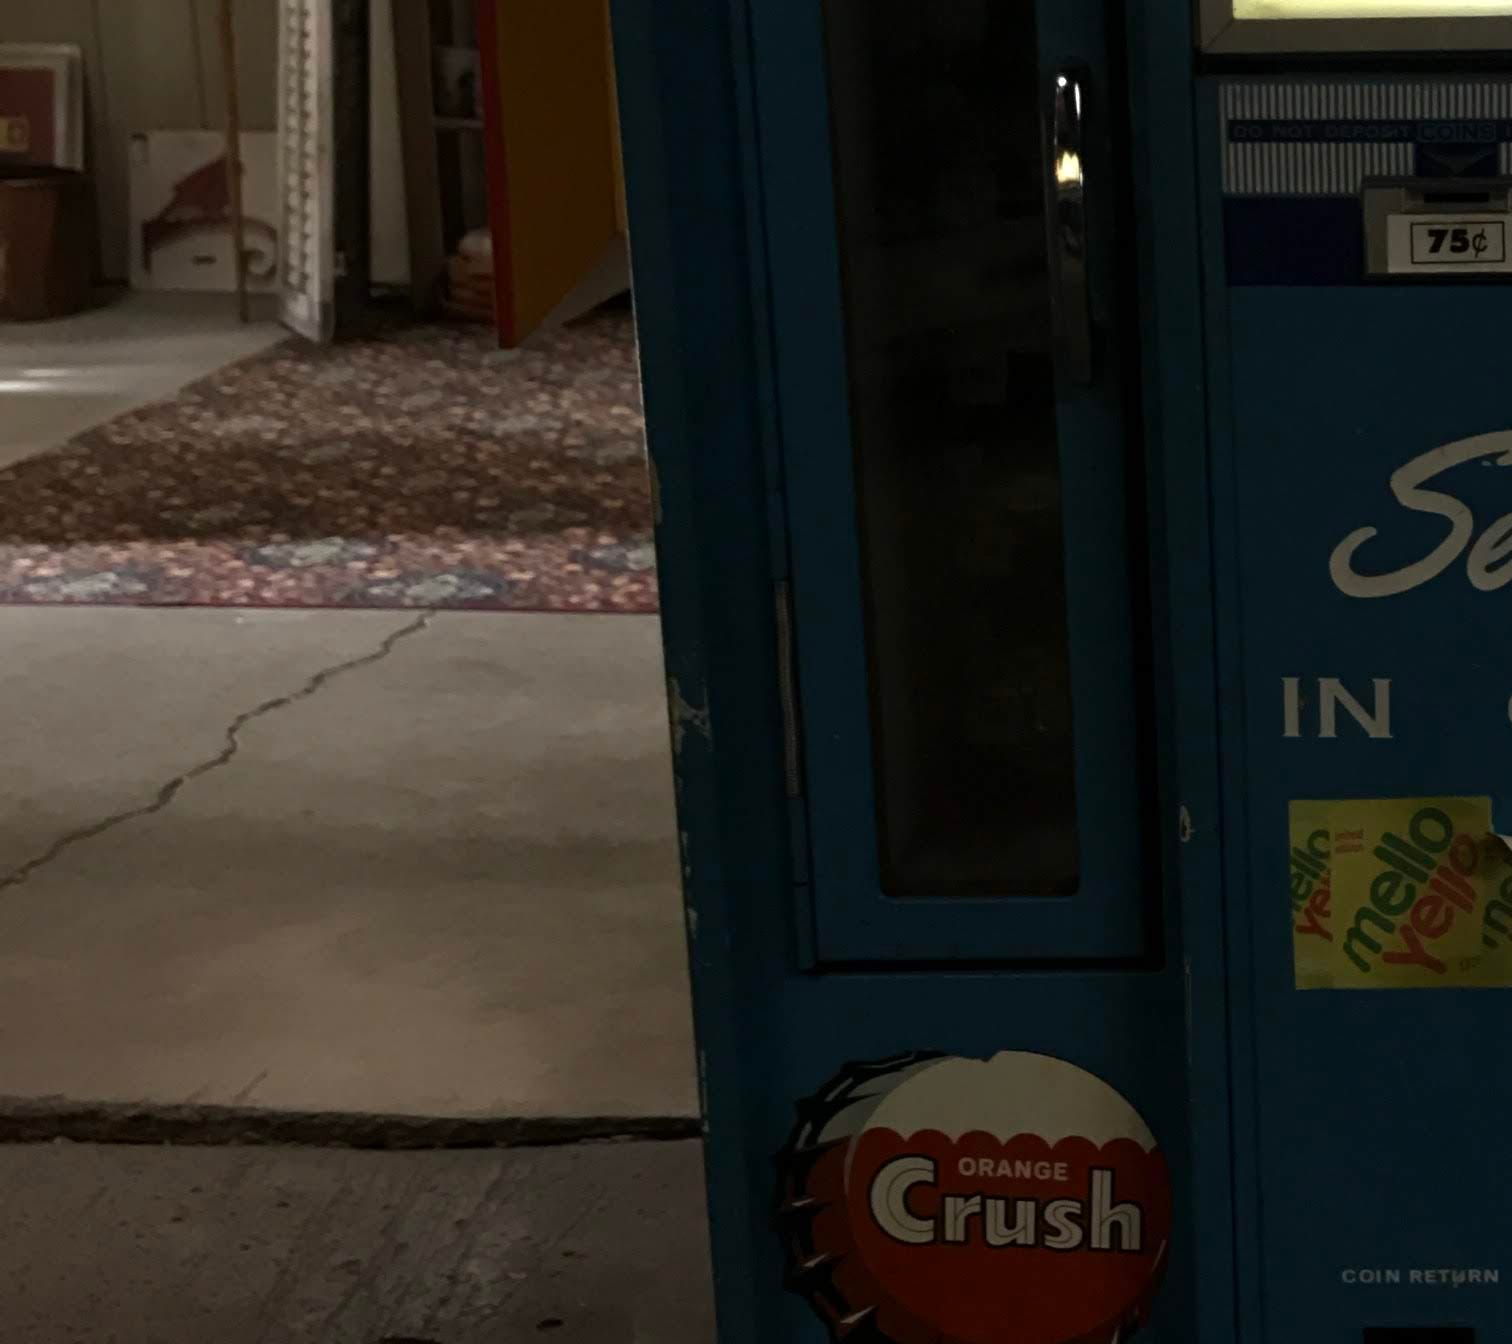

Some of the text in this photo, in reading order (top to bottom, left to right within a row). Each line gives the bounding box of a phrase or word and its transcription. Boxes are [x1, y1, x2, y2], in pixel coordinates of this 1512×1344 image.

[1232, 125, 1263, 139] DO
[1271, 125, 1313, 139] NOT
[1325, 125, 1412, 139] DEPOSIT
[1422, 123, 1496, 140] COINS
[1427, 228, 1489, 258] 75¢
[1281, 676, 1394, 738] IN
[1343, 807, 1453, 973] mello
[1382, 833, 1479, 975] Yello
[958, 1156, 1070, 1181] ORANGE
[869, 1154, 1146, 1252] Crush
[1341, 1268, 1500, 1286] COIN RETURN
